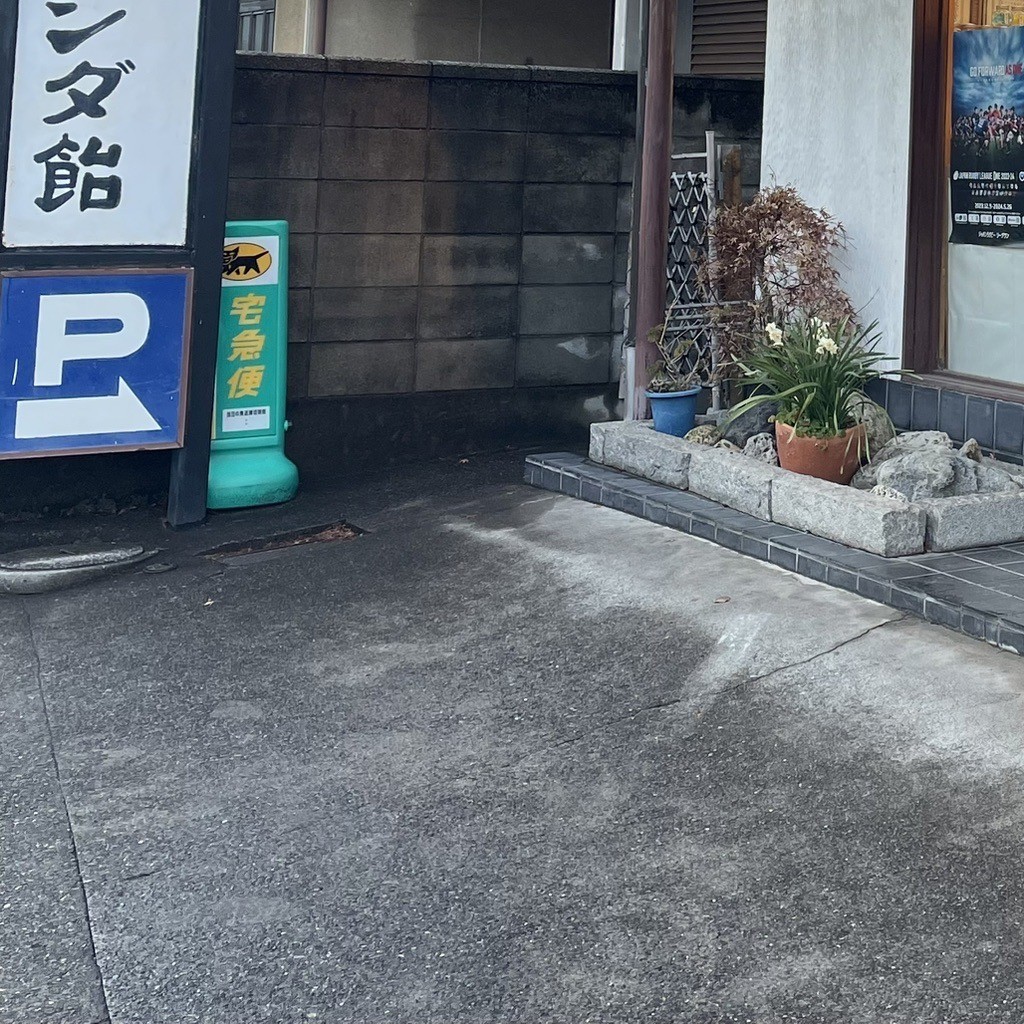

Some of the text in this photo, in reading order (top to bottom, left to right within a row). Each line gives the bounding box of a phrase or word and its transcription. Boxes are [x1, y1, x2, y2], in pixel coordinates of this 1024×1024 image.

[978, 65, 1005, 77] FORWARD
[34, 292, 150, 387] P
[227, 292, 266, 400] 宅急便
